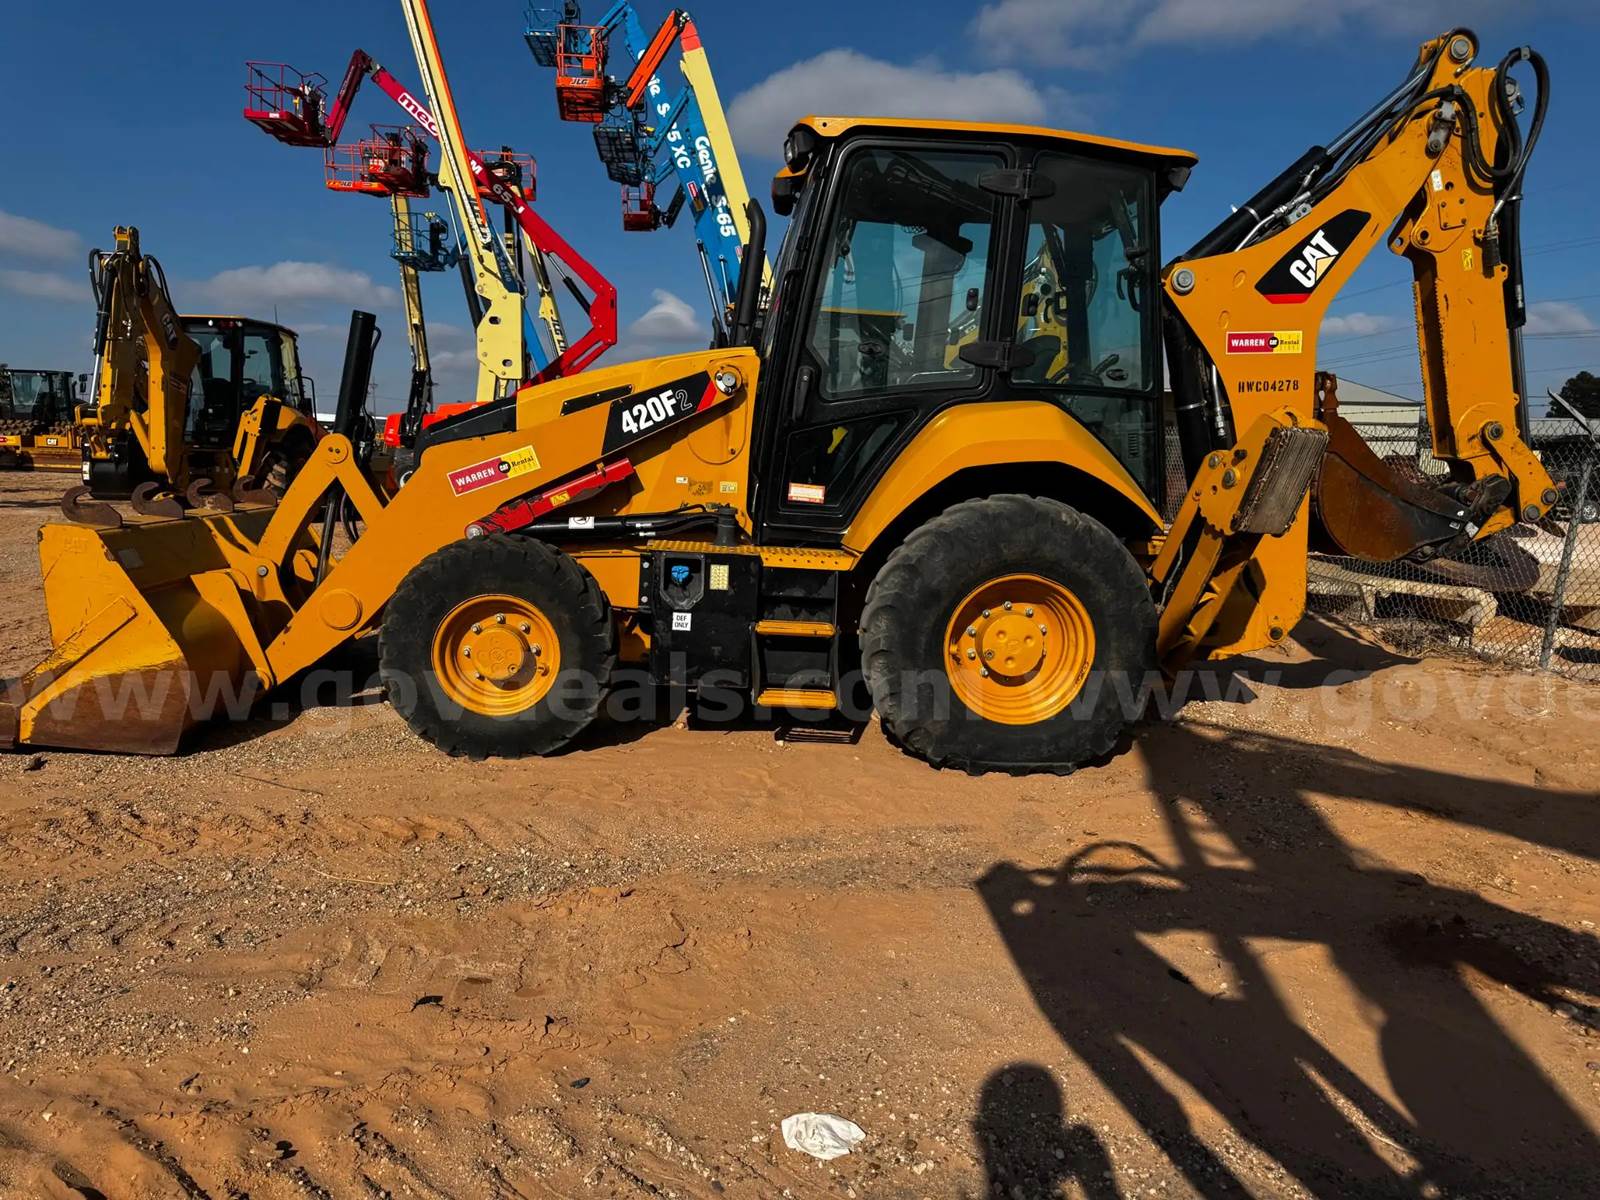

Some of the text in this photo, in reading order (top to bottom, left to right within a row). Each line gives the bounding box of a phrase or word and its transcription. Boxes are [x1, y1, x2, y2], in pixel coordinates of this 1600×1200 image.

[671, 144, 691, 169] XC
[493, 183, 525, 214] 65-J
[695, 136, 717, 185] Genie
[711, 194, 736, 238] S-65
[1289, 229, 1340, 289] CAT
[1231, 339, 1265, 347] WARREN
[620, 388, 693, 435] 420F2
[455, 467, 495, 486] WARREN
[499, 463, 509, 471] CAT
[511, 455, 534, 467] Rental
